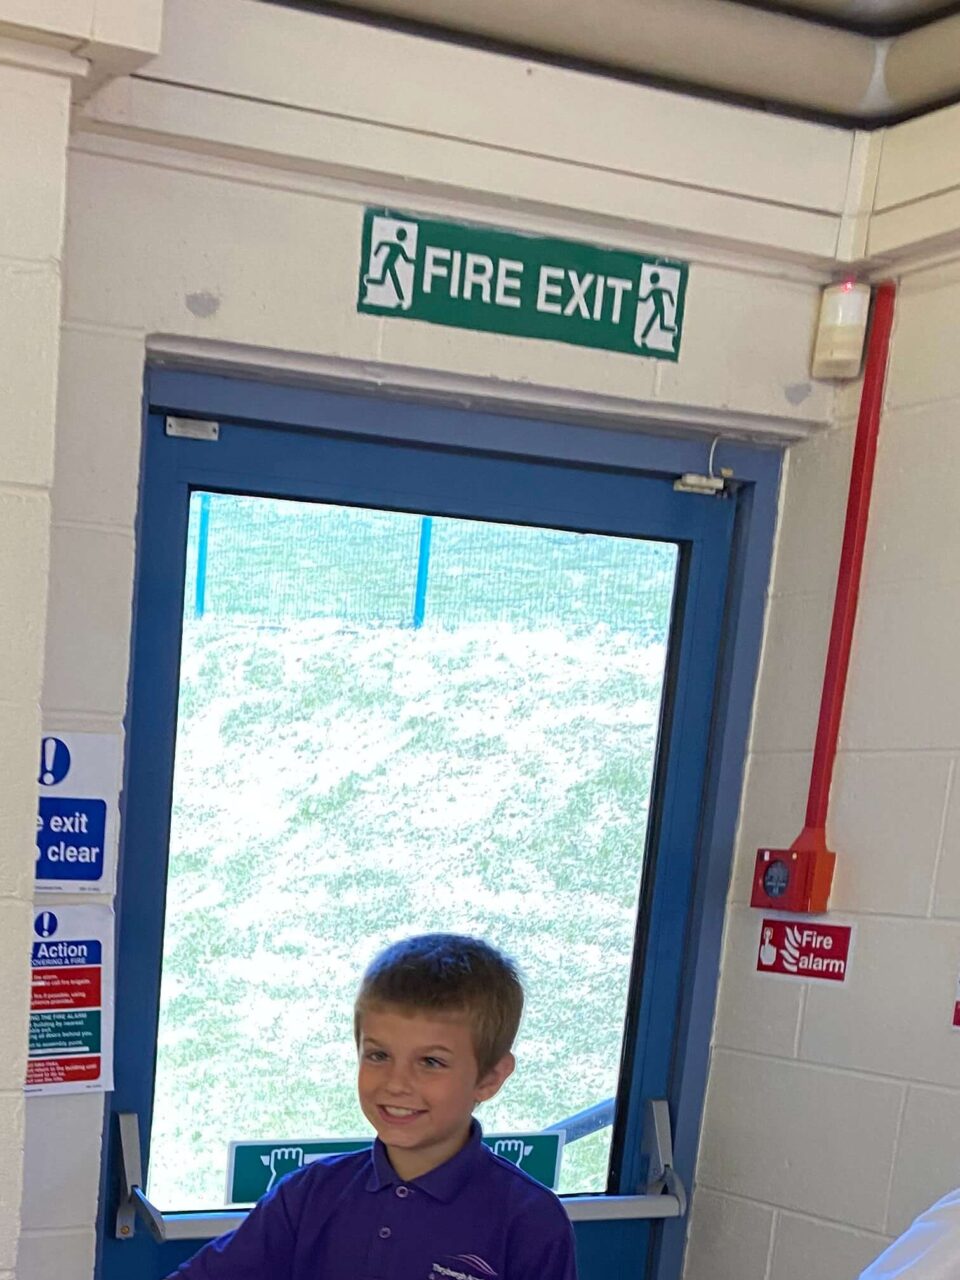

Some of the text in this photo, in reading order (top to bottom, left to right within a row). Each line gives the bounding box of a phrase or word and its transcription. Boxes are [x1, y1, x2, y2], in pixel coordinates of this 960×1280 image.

[422, 245, 633, 324] FIRE EXIT
[49, 812, 88, 833] exit
[47, 841, 100, 863] clear
[801, 930, 833, 950] Fire
[37, 942, 88, 959] Action
[798, 953, 845, 973] alarm
